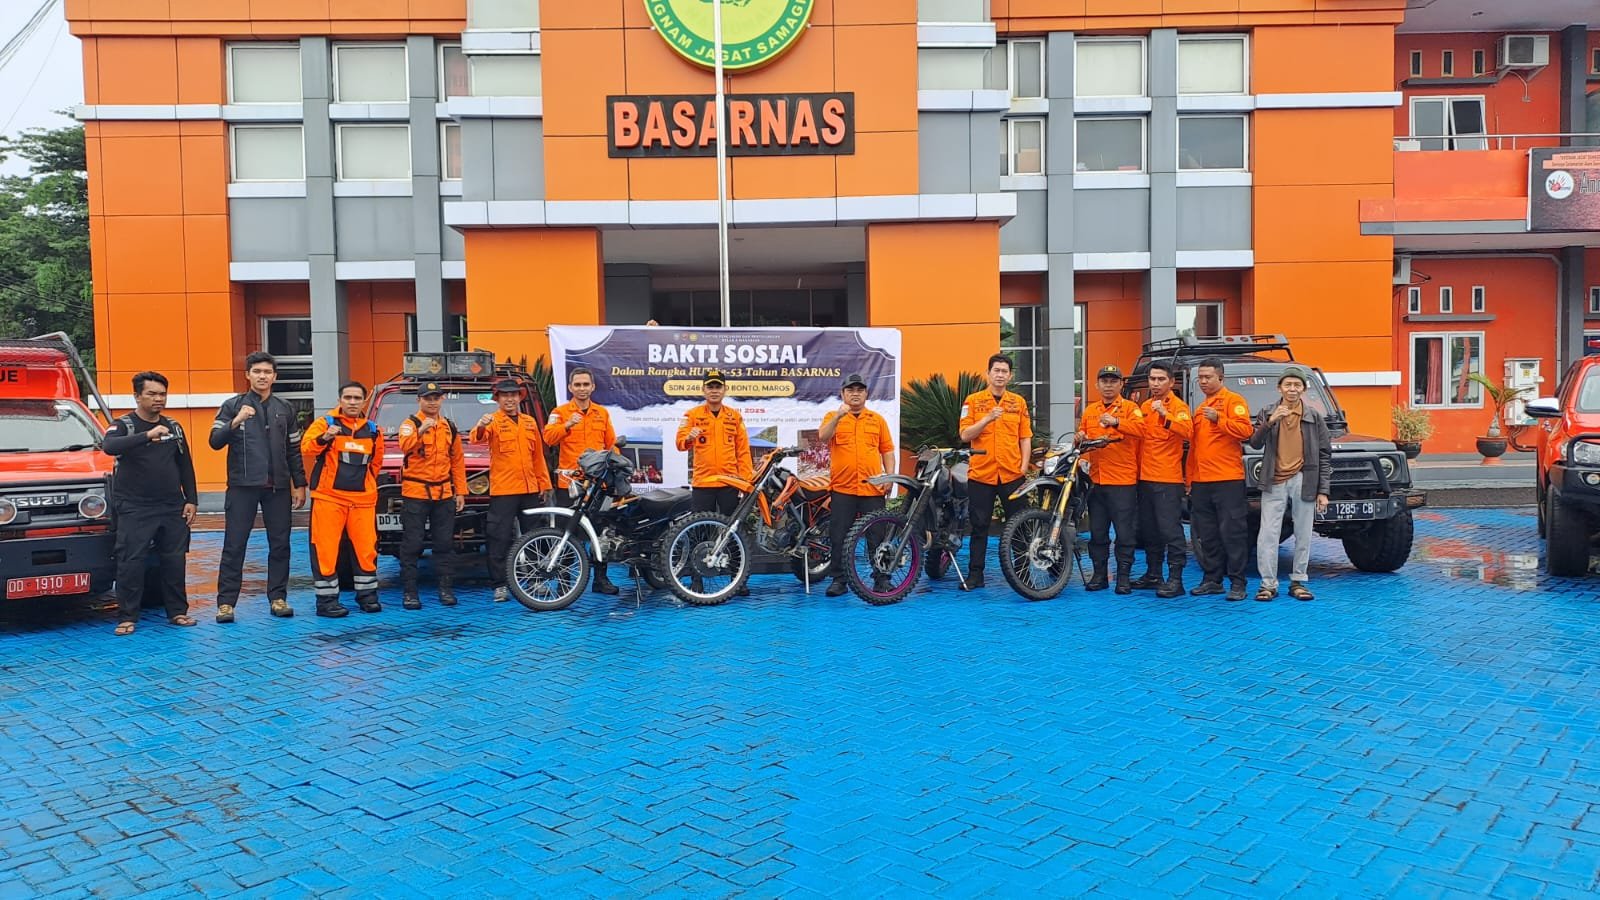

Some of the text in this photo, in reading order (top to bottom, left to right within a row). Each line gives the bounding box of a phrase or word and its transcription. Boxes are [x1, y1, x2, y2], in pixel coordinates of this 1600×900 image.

[695, 47, 751, 62] JAGAT
[613, 98, 846, 148] BASARNAS
[648, 343, 807, 364] BAKTI SOSIAL
[611, 366, 645, 376] Dalam
[648, 366, 686, 378] Rangka
[746, 367, 777, 377] Tahun
[780, 367, 841, 377] BASARNAS
[668, 384, 685, 392] SDN
[731, 384, 760, 393] BONTO,
[761, 384, 790, 392] MAROS
[11, 495, 65, 507] ISUZU
[1336, 503, 1356, 515] 1285
[1362, 503, 1374, 514] CB
[379, 515, 392, 525] DD
[8, 573, 88, 593] DD 1910 IW
